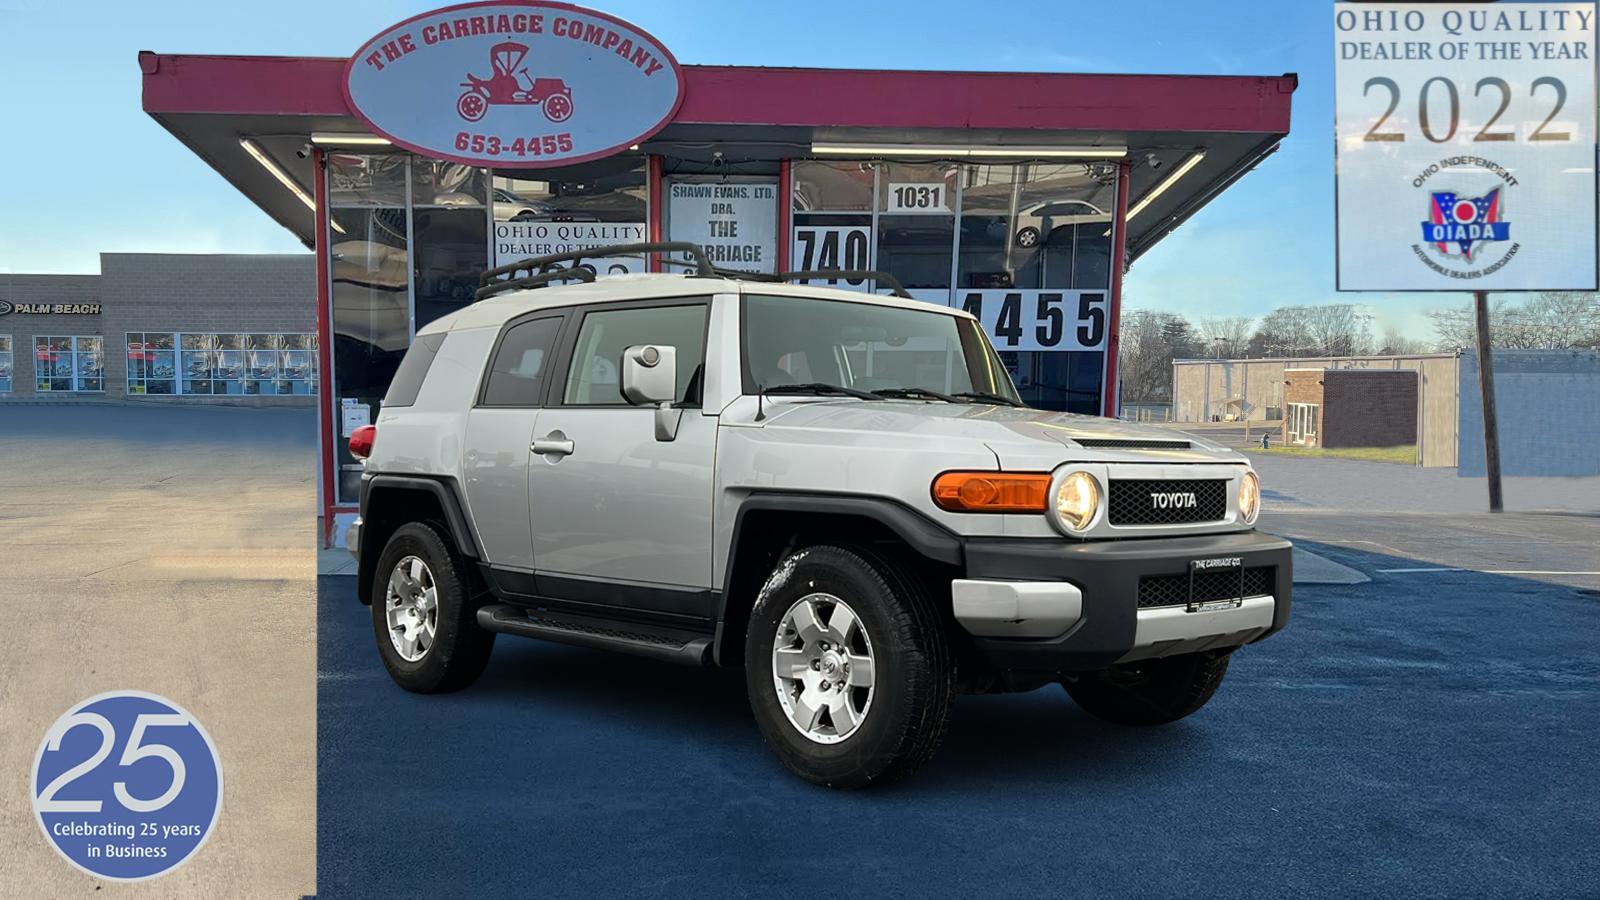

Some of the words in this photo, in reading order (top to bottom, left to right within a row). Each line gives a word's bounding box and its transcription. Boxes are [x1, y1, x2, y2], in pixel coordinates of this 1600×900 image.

[1336, 10, 1425, 31] OHIO
[1442, 10, 1593, 35] QUALITY
[366, 34, 417, 71] THE
[422, 14, 544, 45] CARRIAGE
[552, 17, 664, 77] COMPANY
[1340, 42, 1433, 60] DEALER
[1438, 42, 1470, 60] OF
[1475, 42, 1522, 60] THE
[1527, 42, 1589, 60] YEAR
[1363, 76, 1571, 143] 2022
[455, 132, 573, 157] 653-4455
[1412, 164, 1439, 188] OHIO
[1440, 156, 1519, 187] INDEPENDENT
[672, 186, 712, 198] SHAWN
[754, 187, 774, 199] LTD.
[894, 187, 940, 208] 1031
[711, 203, 736, 215] DBA.
[497, 226, 548, 239] OHIO
[557, 226, 644, 241] QUALITY
[708, 221, 737, 237] THE
[1432, 224, 1495, 241] OIADA
[500, 243, 551, 255] DEALER
[683, 245, 762, 262] CRRIAGE
[797, 230, 867, 286] 740
[1449, 270, 1482, 280] DEALERS
[14, 303, 51, 314] PALM
[54, 304, 100, 314] BEACH
[1151, 492, 1197, 509] TOYOTA
